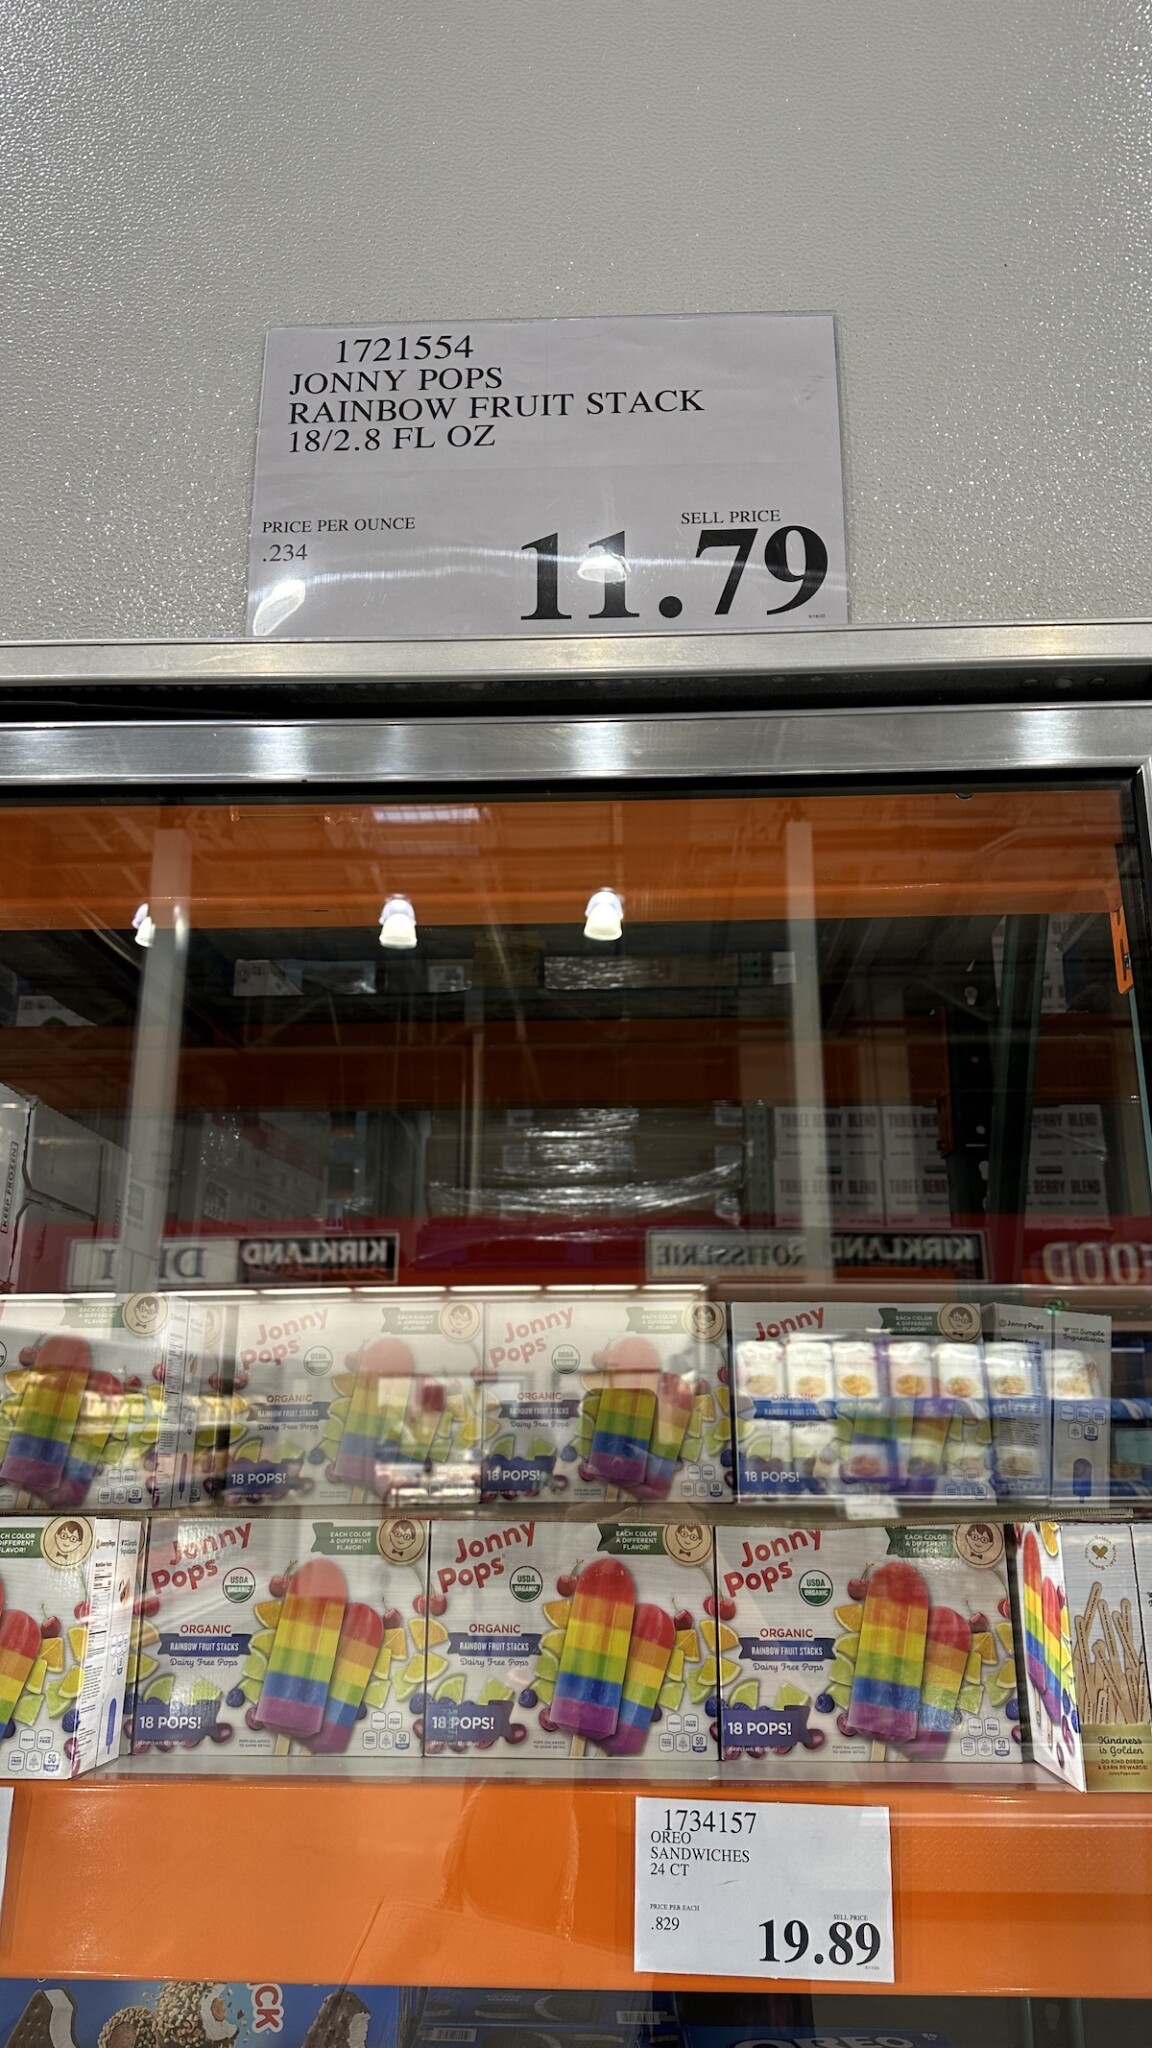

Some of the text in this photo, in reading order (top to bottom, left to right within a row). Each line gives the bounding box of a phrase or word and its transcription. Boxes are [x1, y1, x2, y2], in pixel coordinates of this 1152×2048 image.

[337, 335, 474, 363] 1721554
[289, 367, 502, 395] JONNY POPS
[288, 390, 704, 424] RAINBOW FRUIT STACK
[288, 424, 496, 453] 18/2.8 FL OZ
[681, 509, 780, 524] SELL PRICE
[262, 517, 415, 533] PRICE PER OUNCE
[262, 544, 308, 562] .234
[519, 525, 828, 621] 11.79
[7, 1147, 17, 1196] FROZEN
[848, 1180, 877, 1194] BLEND
[1071, 1180, 1100, 1194] BLEND
[256, 1308, 328, 1345] Jonny
[504, 1307, 573, 1343] Jonny
[756, 1307, 824, 1342] Jonny
[241, 1340, 300, 1370] Pops
[489, 1338, 547, 1368] Pops
[266, 1395, 312, 1403] ORGANIC
[517, 1392, 562, 1400] ORGANIC
[231, 1473, 286, 1484] 18 POPS!
[487, 1470, 540, 1481] 18 POPS!
[745, 1471, 800, 1482] 18 POPS!
[131, 1489, 139, 1497] 50
[170, 1522, 251, 1565] Jonny
[455, 1520, 535, 1563] Jonny
[741, 1530, 821, 1567] Jonny
[151, 1560, 218, 1594] Pops
[437, 1557, 504, 1593] Pops
[724, 1561, 793, 1597] Pops
[806, 1579, 825, 1587] USDA
[180, 1625, 231, 1634] ORGANIC
[469, 1624, 520, 1633] ORGANIC
[760, 1628, 813, 1637] ORGANIC
[216, 1643, 239, 1651] STACKS
[460, 1642, 529, 1651] RAINBOW FRUIT STACKS
[751, 1647, 823, 1656] RAINBOW FRUIT STACKS
[170, 1658, 195, 1668] Dairy
[218, 1658, 238, 1667] Pops
[460, 1658, 529, 1668] Dairy Free Pops
[753, 1663, 778, 1672] Dairy
[802, 1663, 824, 1672] Pops
[140, 1716, 201, 1729] 18 POPS!
[432, 1716, 494, 1729] 18 POPS!
[728, 1722, 792, 1735] 18 POPS!
[399, 1734, 406, 1742] 50
[696, 1737, 703, 1745] 50
[1098, 1736, 1142, 1744] Kindness
[998, 1741, 1005, 1749] 50
[1110, 1746, 1144, 1757] Golden
[48, 1754, 55, 1763] 50
[664, 1809, 757, 1834] 1734157
[651, 1831, 691, 1844] OREO
[651, 1847, 750, 1863] SANDWICHES
[651, 1863, 689, 1876] 24 CT
[651, 1916, 680, 1930] .829
[759, 1919, 881, 1965] 19.89
[253, 1983, 281, 2030] CK
